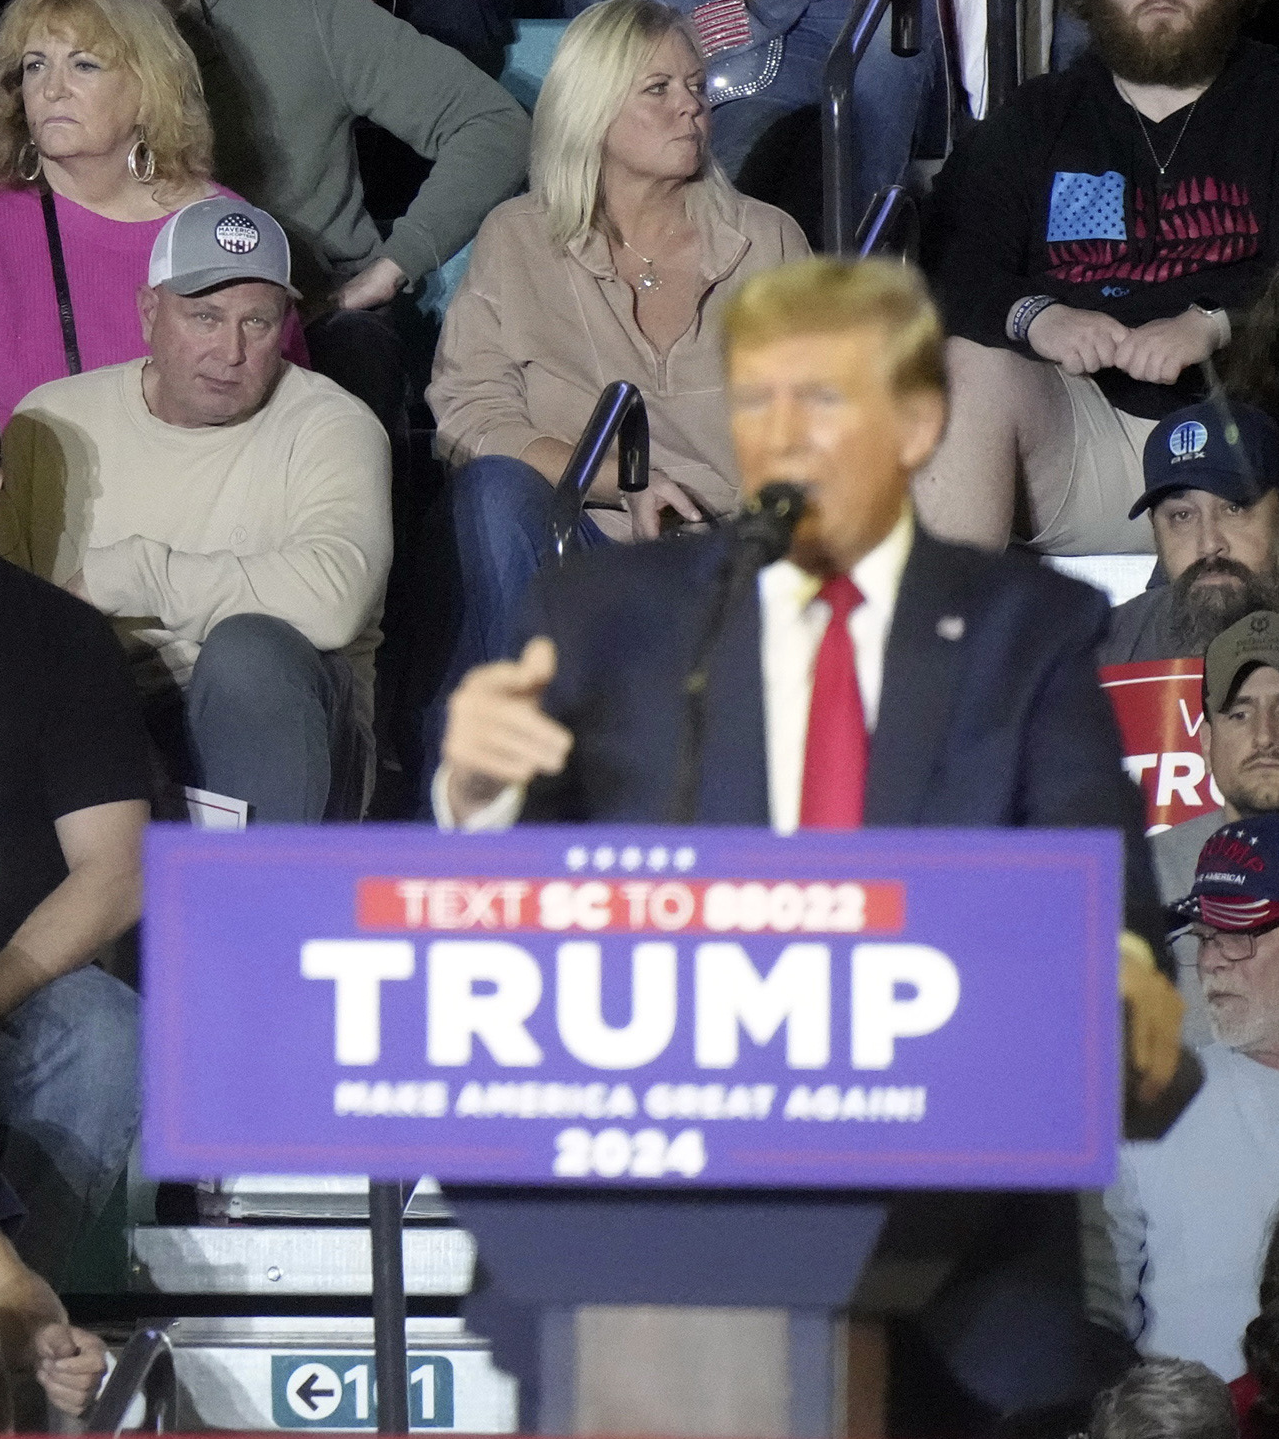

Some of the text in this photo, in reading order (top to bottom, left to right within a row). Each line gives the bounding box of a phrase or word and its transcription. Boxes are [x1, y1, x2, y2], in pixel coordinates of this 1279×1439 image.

[396, 880, 531, 928] TEXT
[623, 885, 696, 932] TO
[701, 883, 866, 933] 88022
[298, 938, 961, 1071] TRUMP
[334, 1080, 928, 1123] MAKE AMERICA GREAT AGAIN!
[552, 1127, 707, 1179] 2024
[344, 1364, 436, 1420] 11
